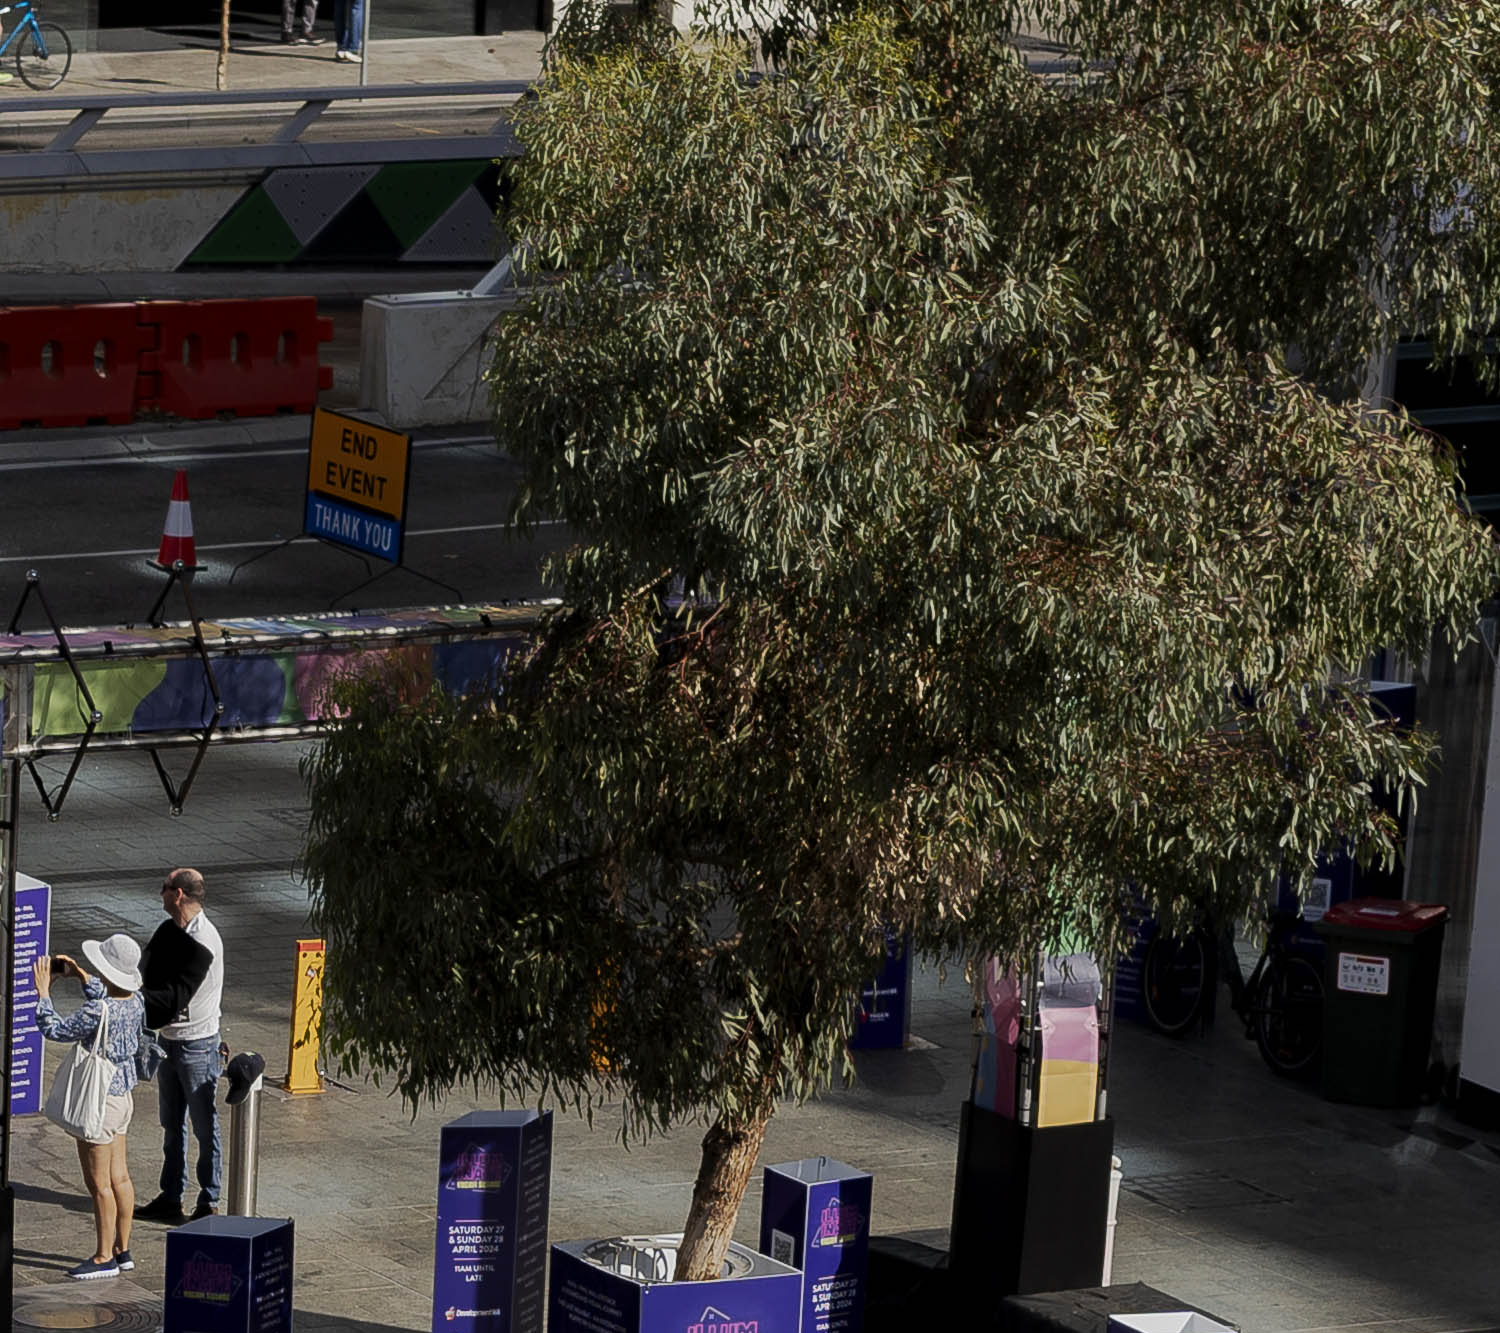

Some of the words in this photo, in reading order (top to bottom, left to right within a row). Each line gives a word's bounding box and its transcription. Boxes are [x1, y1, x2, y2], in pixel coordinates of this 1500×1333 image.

[341, 428, 377, 460] END
[326, 460, 387, 502] EVENT
[314, 503, 360, 542] THANK
[364, 519, 392, 552] YOU
